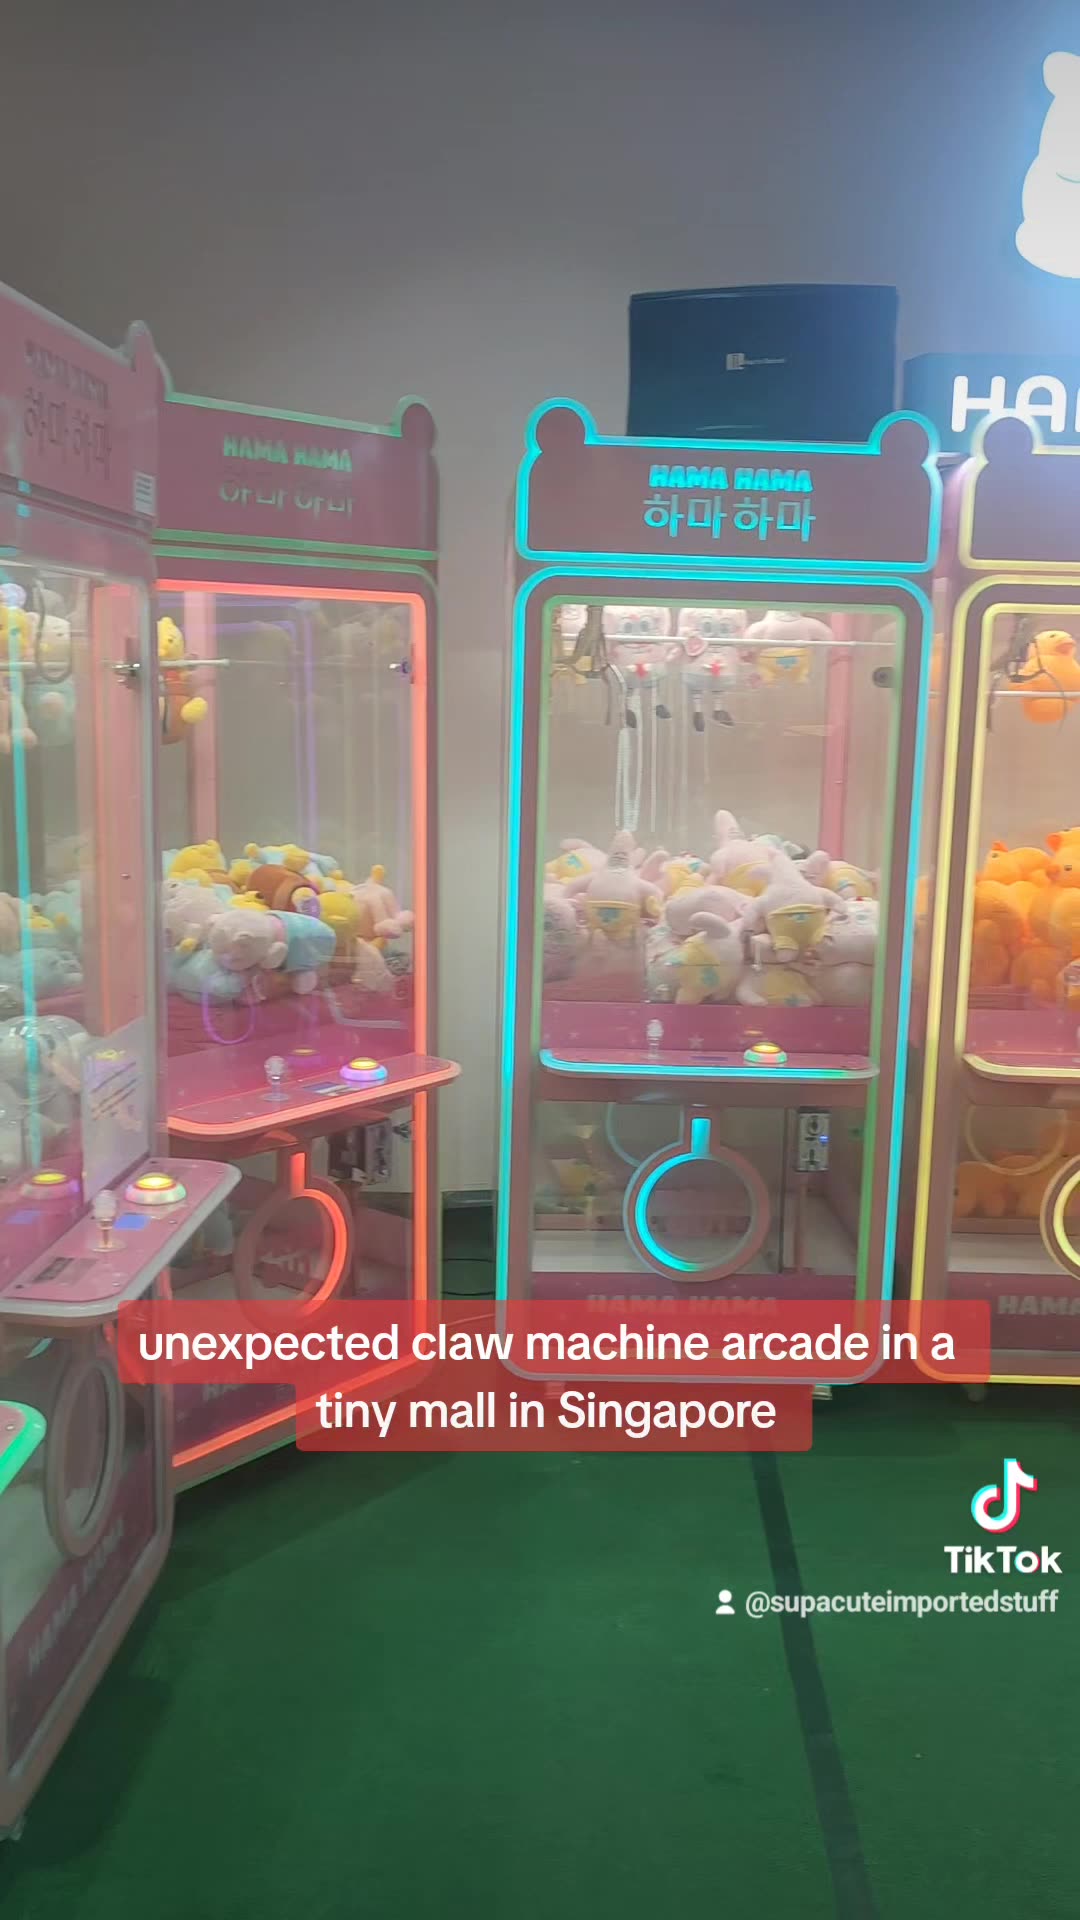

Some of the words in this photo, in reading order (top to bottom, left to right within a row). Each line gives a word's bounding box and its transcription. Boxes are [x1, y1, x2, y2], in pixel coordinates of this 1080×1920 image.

[951, 374, 1080, 433] HA
[223, 432, 289, 465] HAMA
[294, 443, 352, 473] HAMA
[649, 464, 729, 490] HAMA
[734, 467, 813, 493] HAMA
